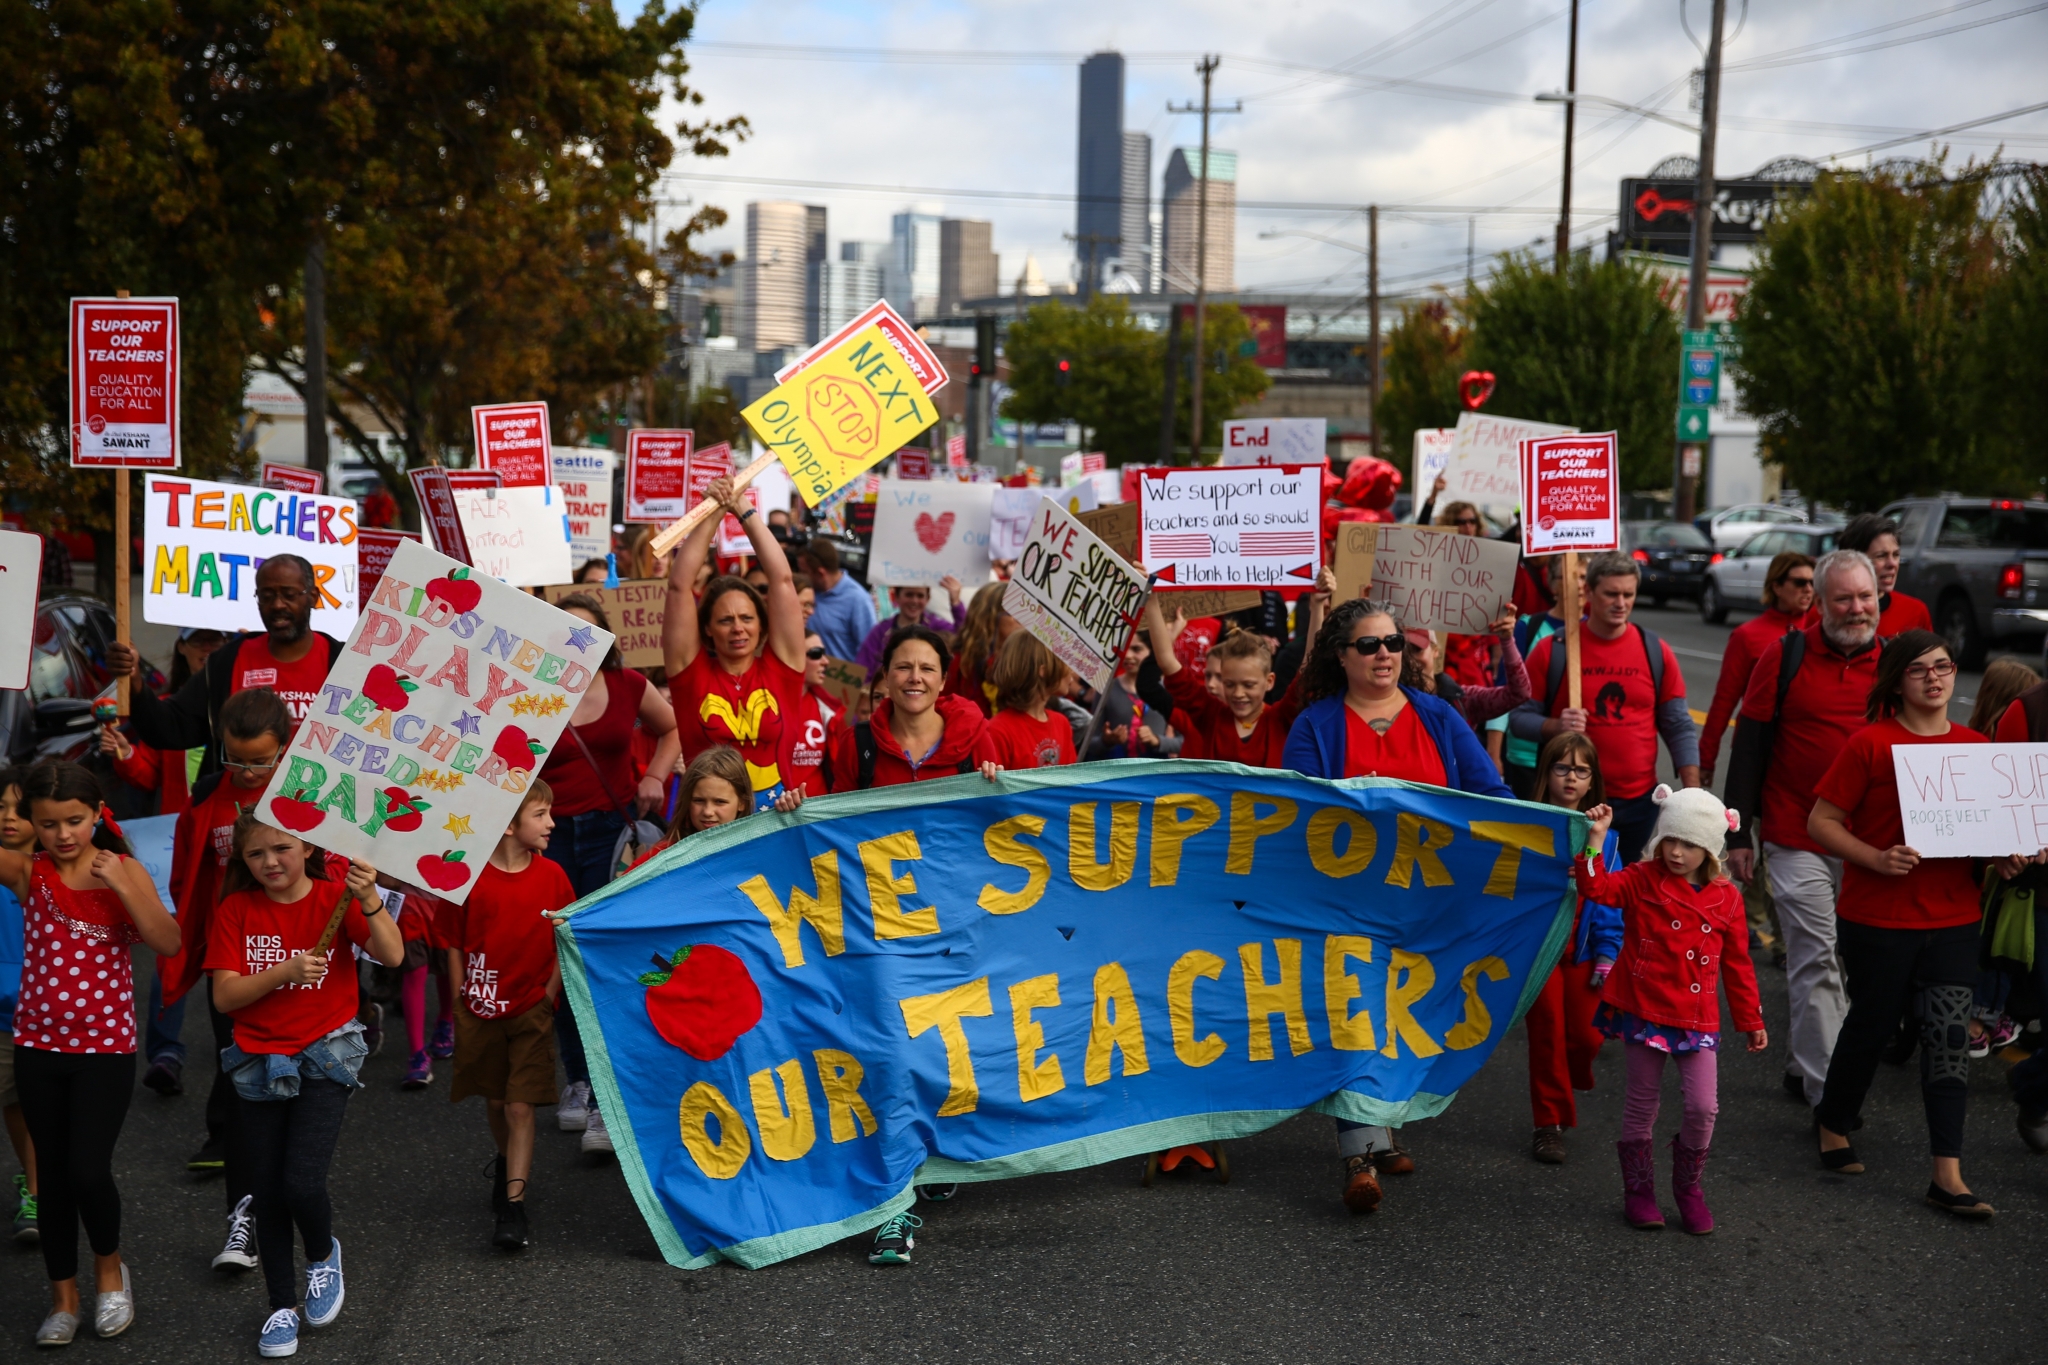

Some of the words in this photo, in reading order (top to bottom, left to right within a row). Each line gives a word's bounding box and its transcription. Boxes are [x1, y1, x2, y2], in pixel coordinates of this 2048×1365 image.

[91, 319, 162, 332] SUPPORT
[110, 335, 143, 347] OUR
[88, 349, 165, 362] TEACHERS
[880, 326, 928, 380] SUPPORT
[98, 374, 153, 385] QUALITY
[848, 340, 923, 425] NEXT
[90, 386, 162, 397] EDUCATION
[100, 398, 125, 409] FOR
[128, 399, 152, 410] ALL
[814, 383, 873, 444] STOP
[490, 418, 538, 430] SUPPORT
[102, 438, 150, 449] SAWANT
[503, 430, 526, 439] OUR
[1230, 426, 1269, 447] End
[489, 438, 542, 451] TEACHERS
[762, 400, 833, 498] Olympia
[1543, 448, 1604, 460] SUPPORT
[497, 455, 536, 465] QUALITY
[1559, 458, 1588, 468] OUR
[1540, 468, 1608, 480] TEACHERS
[894, 490, 931, 507] We
[1143, 476, 1181, 501] We
[1189, 478, 1263, 511] support
[1270, 481, 1301, 495] our
[1541, 494, 1606, 505] EDUCATION
[1549, 485, 1597, 496] QUALITY
[151, 481, 357, 547] TEACHERS
[566, 503, 607, 517] TRACT
[1550, 502, 1573, 512] FOR
[1575, 502, 1597, 511] ALL
[1143, 509, 1209, 531] teachers
[1213, 512, 1238, 527] and
[1243, 513, 1260, 525] so
[1264, 508, 1309, 525] should
[1043, 509, 1079, 562] WE
[1208, 533, 1239, 554] You
[1552, 530, 1595, 538] SAWANT
[1377, 527, 1401, 553] I
[1410, 529, 1479, 565] STAND
[150, 545, 355, 610] MATR!
[1022, 541, 1062, 600] OUR
[1186, 564, 1222, 582] Honk
[1227, 565, 1241, 582] to
[1246, 563, 1283, 586] Help!
[1376, 559, 1431, 582] WITH
[1451, 567, 1493, 593] OUR
[373, 575, 484, 639] KIDS
[481, 625, 592, 694] NEED
[351, 608, 528, 716] PLAY
[323, 683, 532, 794] TEACHERS
[299, 720, 420, 787] NEED
[1903, 755, 1976, 803] WE
[1991, 753, 2048, 800] SUP
[276, 754, 415, 838] PAY
[1909, 809, 1991, 825] ROOSEVELT
[2001, 804, 2048, 845] TE
[1935, 823, 1955, 836] HS
[738, 830, 941, 968] WE
[976, 790, 1555, 915] SUPPORT
[246, 935, 282, 948] KIDS
[246, 948, 287, 962] NEED
[679, 1048, 878, 1180] OUR
[898, 933, 1511, 1118] TEACHERS
